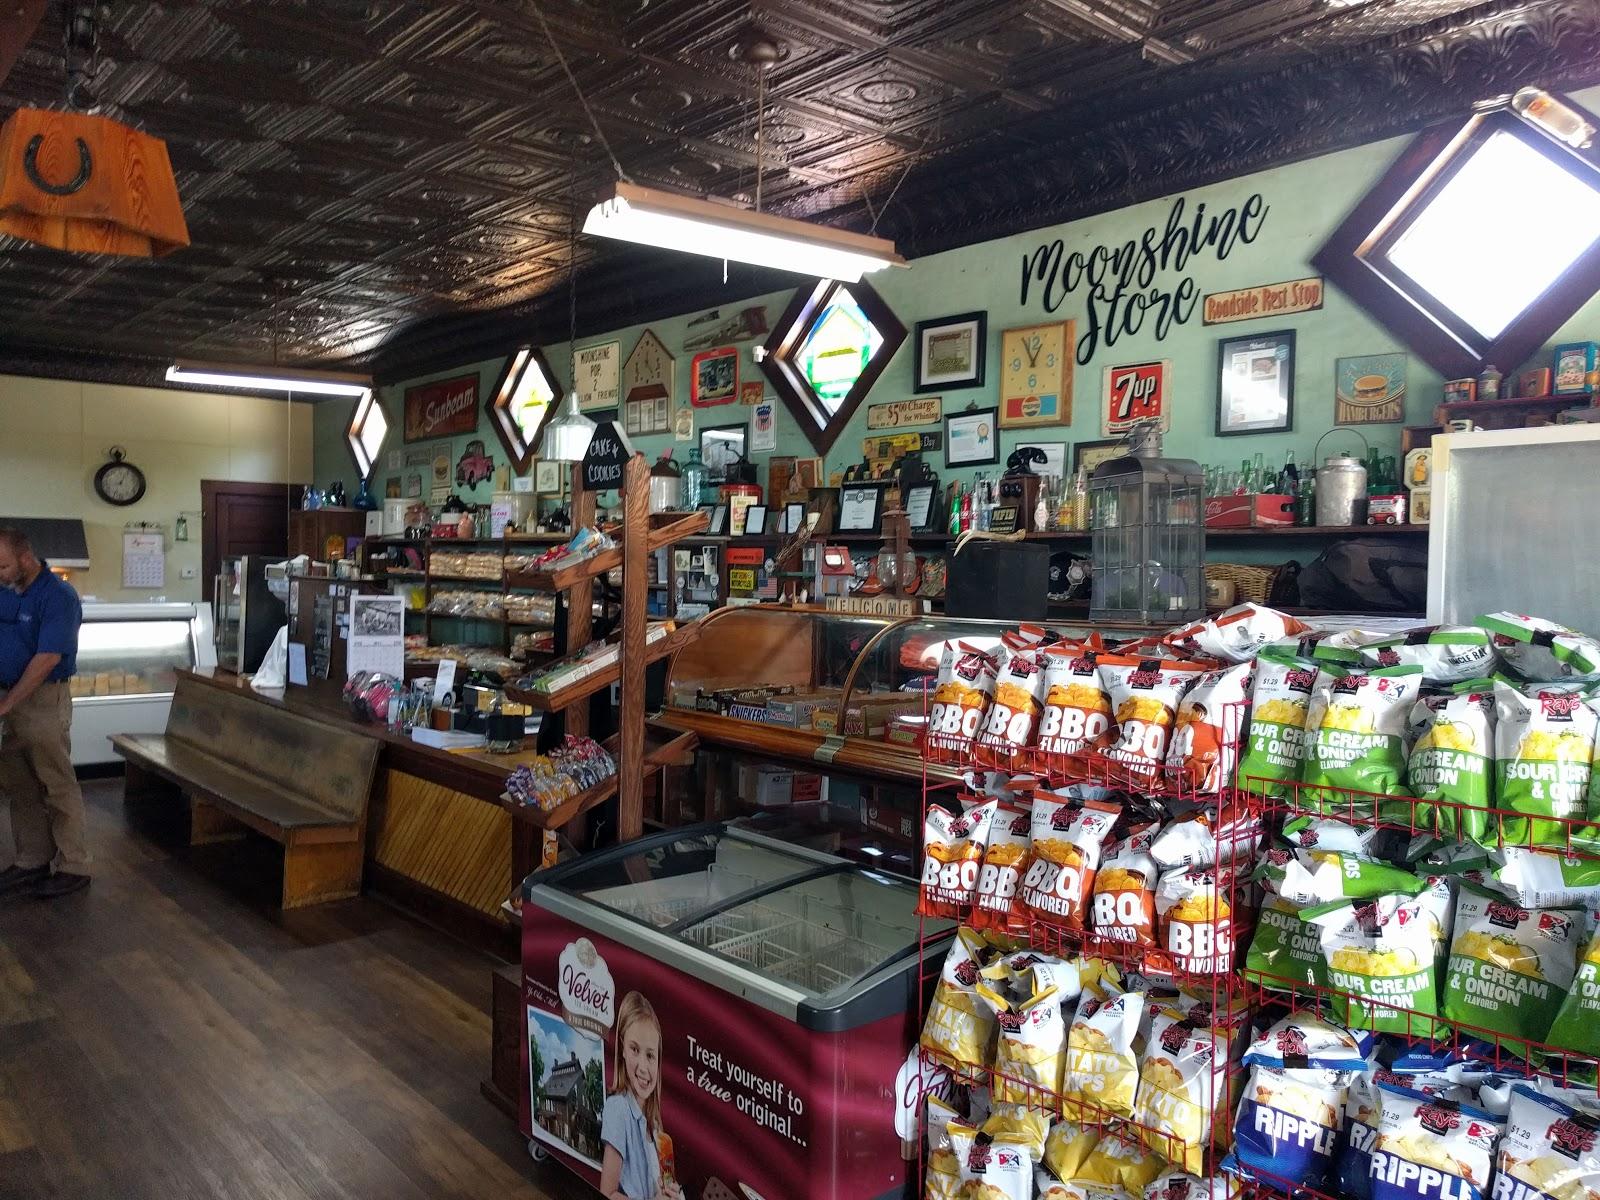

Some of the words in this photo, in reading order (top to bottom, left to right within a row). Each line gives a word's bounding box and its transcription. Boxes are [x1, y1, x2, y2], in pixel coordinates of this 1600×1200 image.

[1020, 194, 1271, 314] Moonshine
[1207, 292, 1258, 321] Roadside
[1262, 285, 1288, 311] Rest
[1290, 279, 1320, 308] Stop
[1077, 276, 1201, 366] Store
[580, 346, 610, 365] MOONSHINE
[425, 384, 475, 433] Sunbeam
[908, 400, 935, 412] Charge
[1338, 402, 1401, 422] HAMBURGERS
[589, 438, 612, 457] CAKE
[923, 435, 936, 449] Day
[588, 463, 621, 483] COOKIES
[827, 597, 910, 616] WELCOME
[1448, 653, 1474, 666] UNCLE
[1263, 677, 1278, 686] $1.29
[929, 703, 985, 738] BBQ
[1250, 722, 1279, 739] OUR
[1254, 737, 1264, 752] &
[1268, 739, 1306, 761] ONIO
[1329, 731, 1389, 749] CREAM
[1266, 755, 1297, 768] FLAVORED
[1424, 750, 1485, 775] CREAM
[1413, 767, 1459, 786] ONION
[1506, 763, 1557, 782] SOUR
[1531, 780, 1545, 800] &
[1035, 812, 1047, 820] $1.29
[977, 864, 1019, 898] BB
[1024, 858, 1081, 902] BBQ
[1023, 886, 1070, 917] FLAVORED
[1091, 891, 1150, 927] BQ
[1460, 903, 1478, 912] $1.29
[1277, 931, 1288, 946] &
[1289, 948, 1319, 963] FLAVORED
[562, 964, 610, 1013] Velvet
[1370, 971, 1430, 995] CREAM
[1450, 973, 1461, 990] &
[1465, 976, 1522, 1007] ONION
[1479, 963, 1549, 1001] CREAM
[1463, 994, 1499, 1011] FLAVORED
[686, 1034, 723, 1073] Treat
[726, 1061, 784, 1105] yourself
[787, 1090, 803, 1115] to
[686, 1066, 695, 1084] a
[698, 1071, 733, 1103] true
[736, 1094, 807, 1148] original...
[1381, 1109, 1400, 1121] $1.29
[1254, 1105, 1336, 1157] RIPPLE
[1510, 1125, 1531, 1140] $1.29
